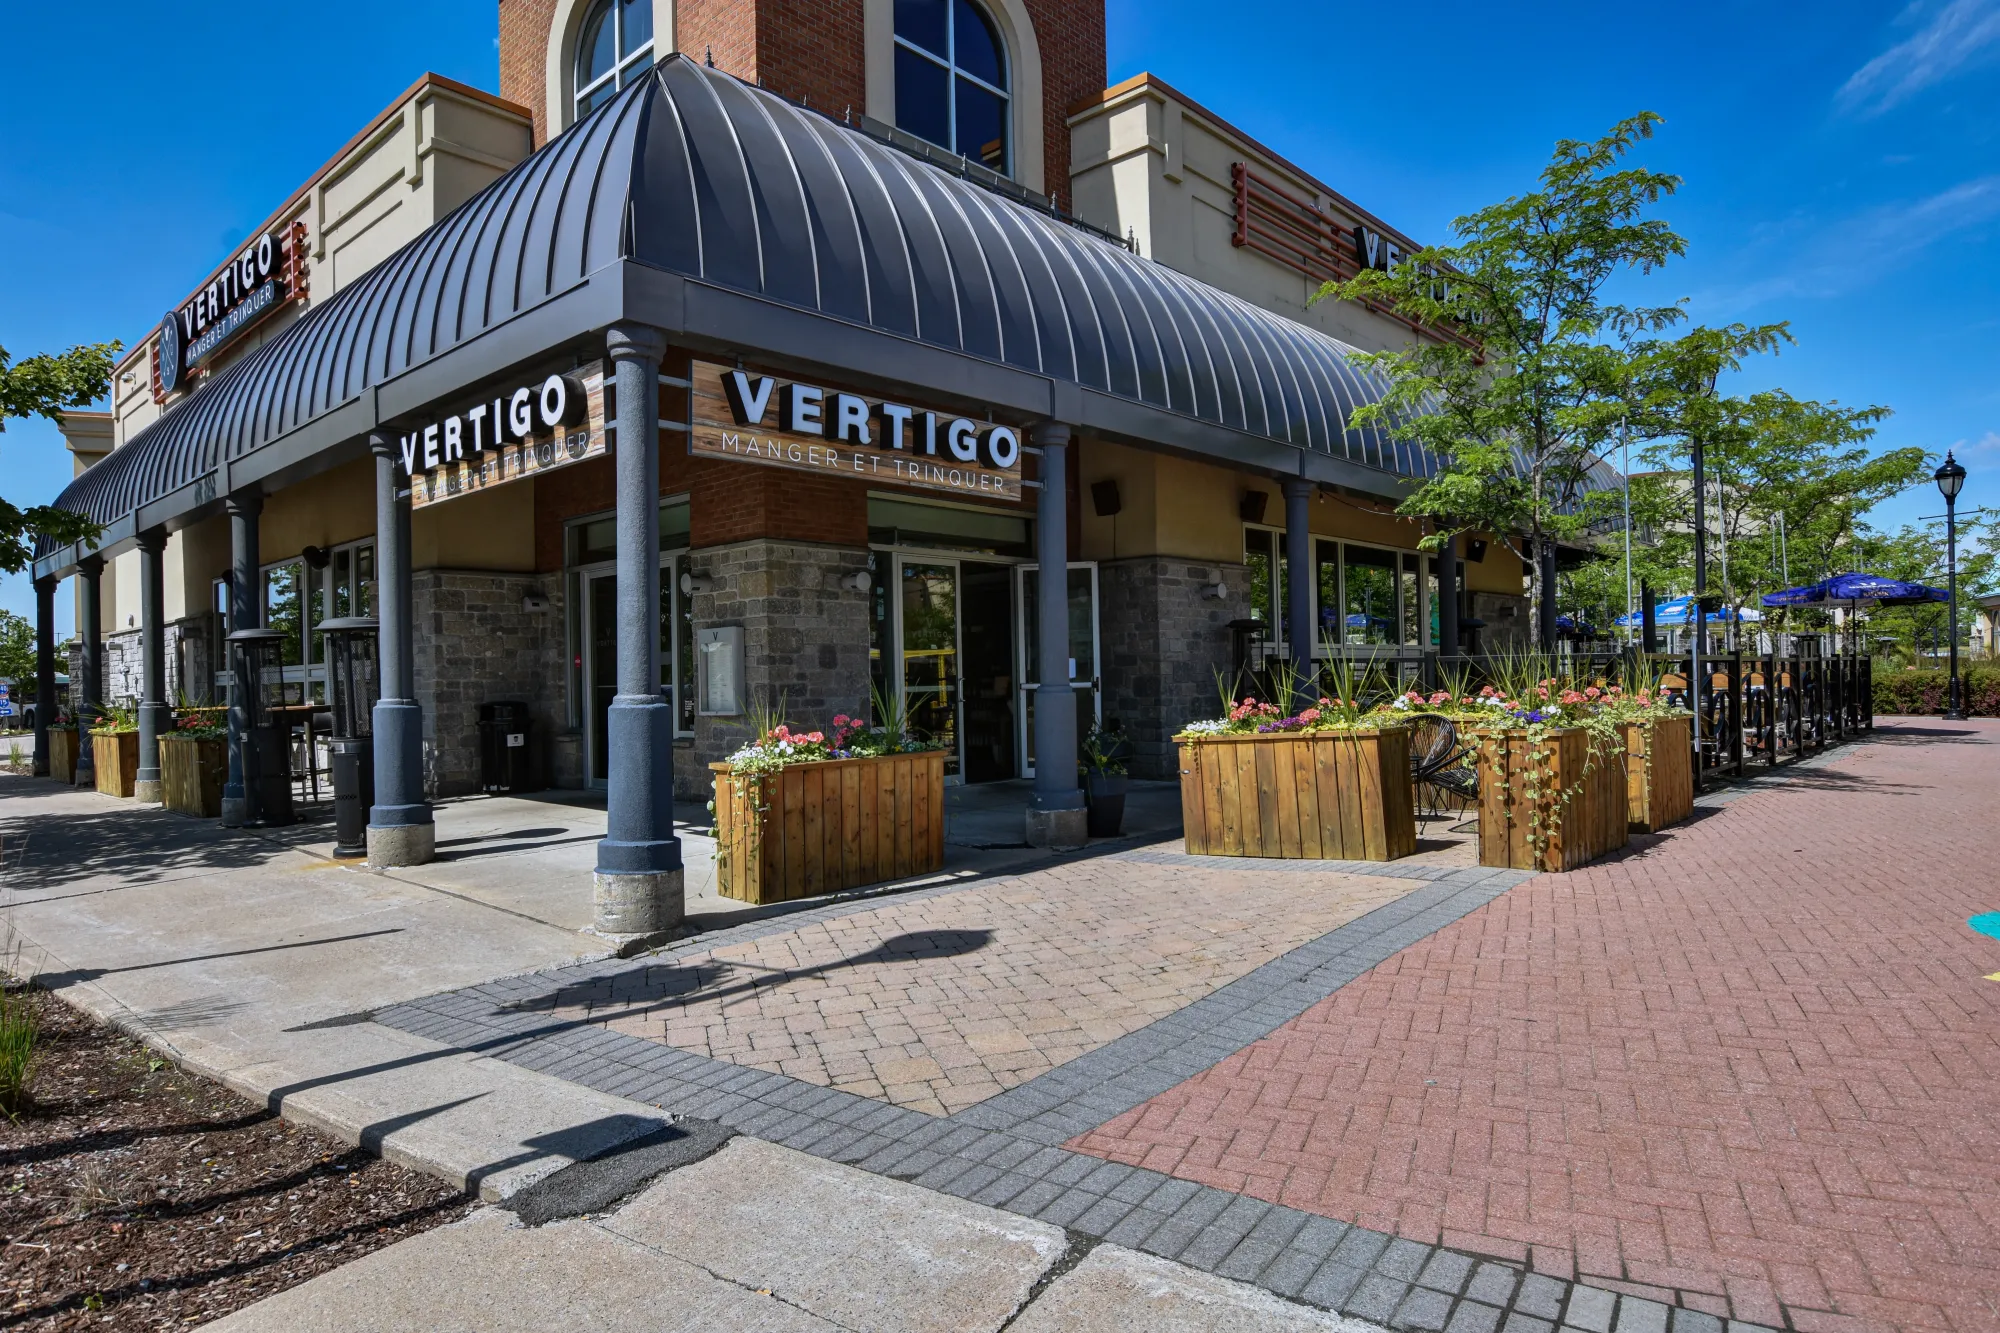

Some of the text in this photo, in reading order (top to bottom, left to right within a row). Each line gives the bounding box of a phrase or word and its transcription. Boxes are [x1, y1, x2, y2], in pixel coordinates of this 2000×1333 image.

[184, 233, 272, 340] VERTIGO
[187, 285, 272, 362] MANGER ET TRINQUER
[401, 374, 566, 476] VERTIGO
[730, 370, 1019, 469] VERTIGO
[421, 432, 588, 500] MANGER ET TRINQUER
[722, 432, 1004, 492] MANGER ET TRINQUER
[712, 631, 719, 641] V
